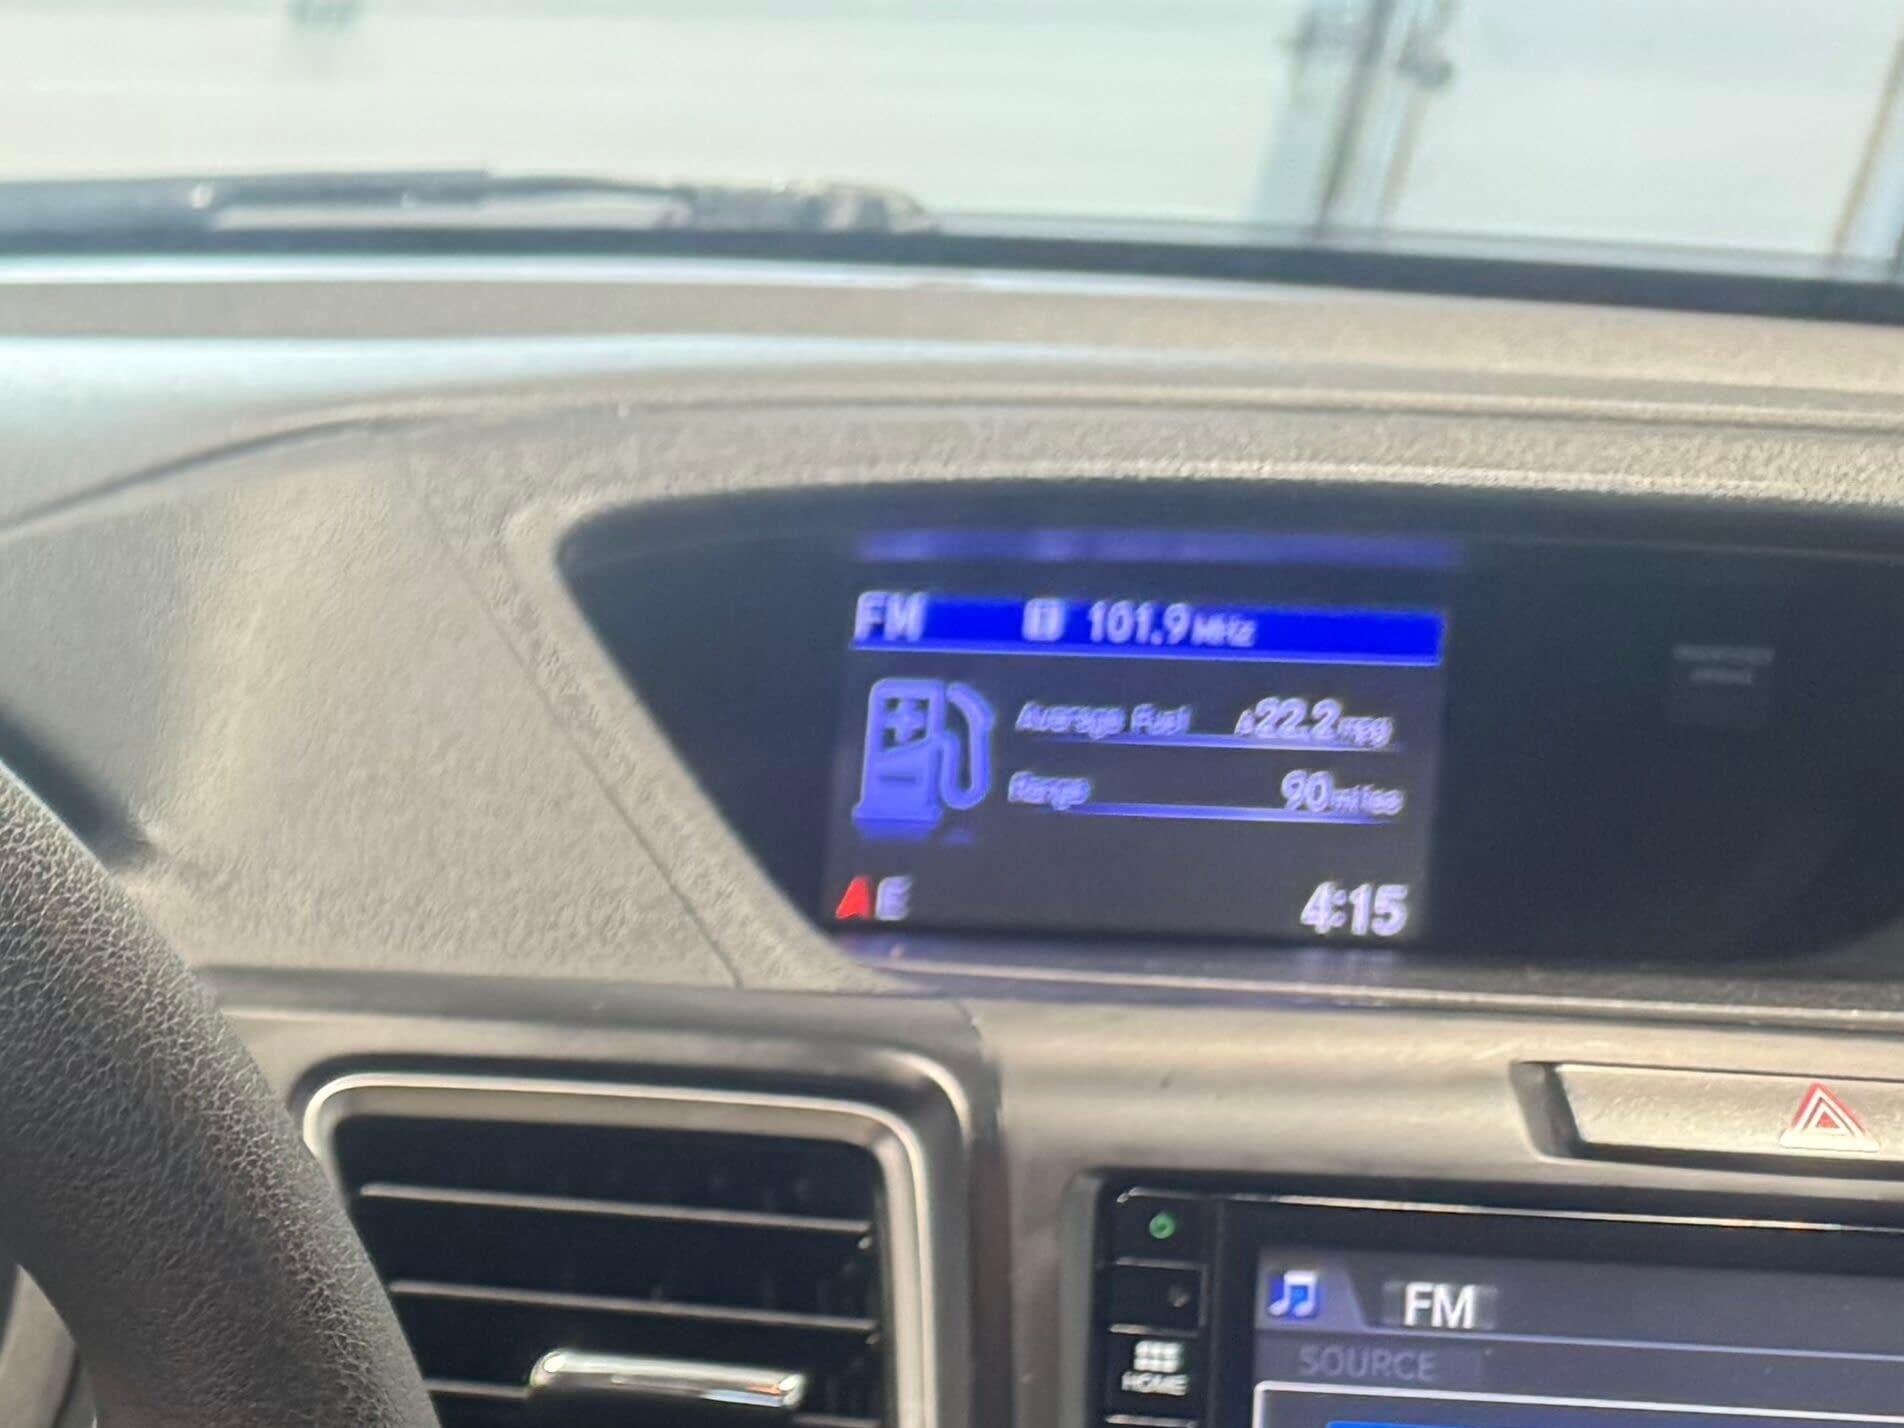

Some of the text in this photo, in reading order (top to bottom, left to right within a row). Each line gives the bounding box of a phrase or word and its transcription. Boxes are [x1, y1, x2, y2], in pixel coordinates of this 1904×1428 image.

[854, 590, 927, 642] FM
[1088, 600, 1188, 646] 101.9
[1016, 701, 1190, 739] Average Fuel
[1008, 771, 1090, 811] Range
[1301, 881, 1408, 936] 4:15
[1404, 1283, 1474, 1330] FM
[1121, 1371, 1188, 1396] HOME
[1299, 1346, 1436, 1382] SOURCE
